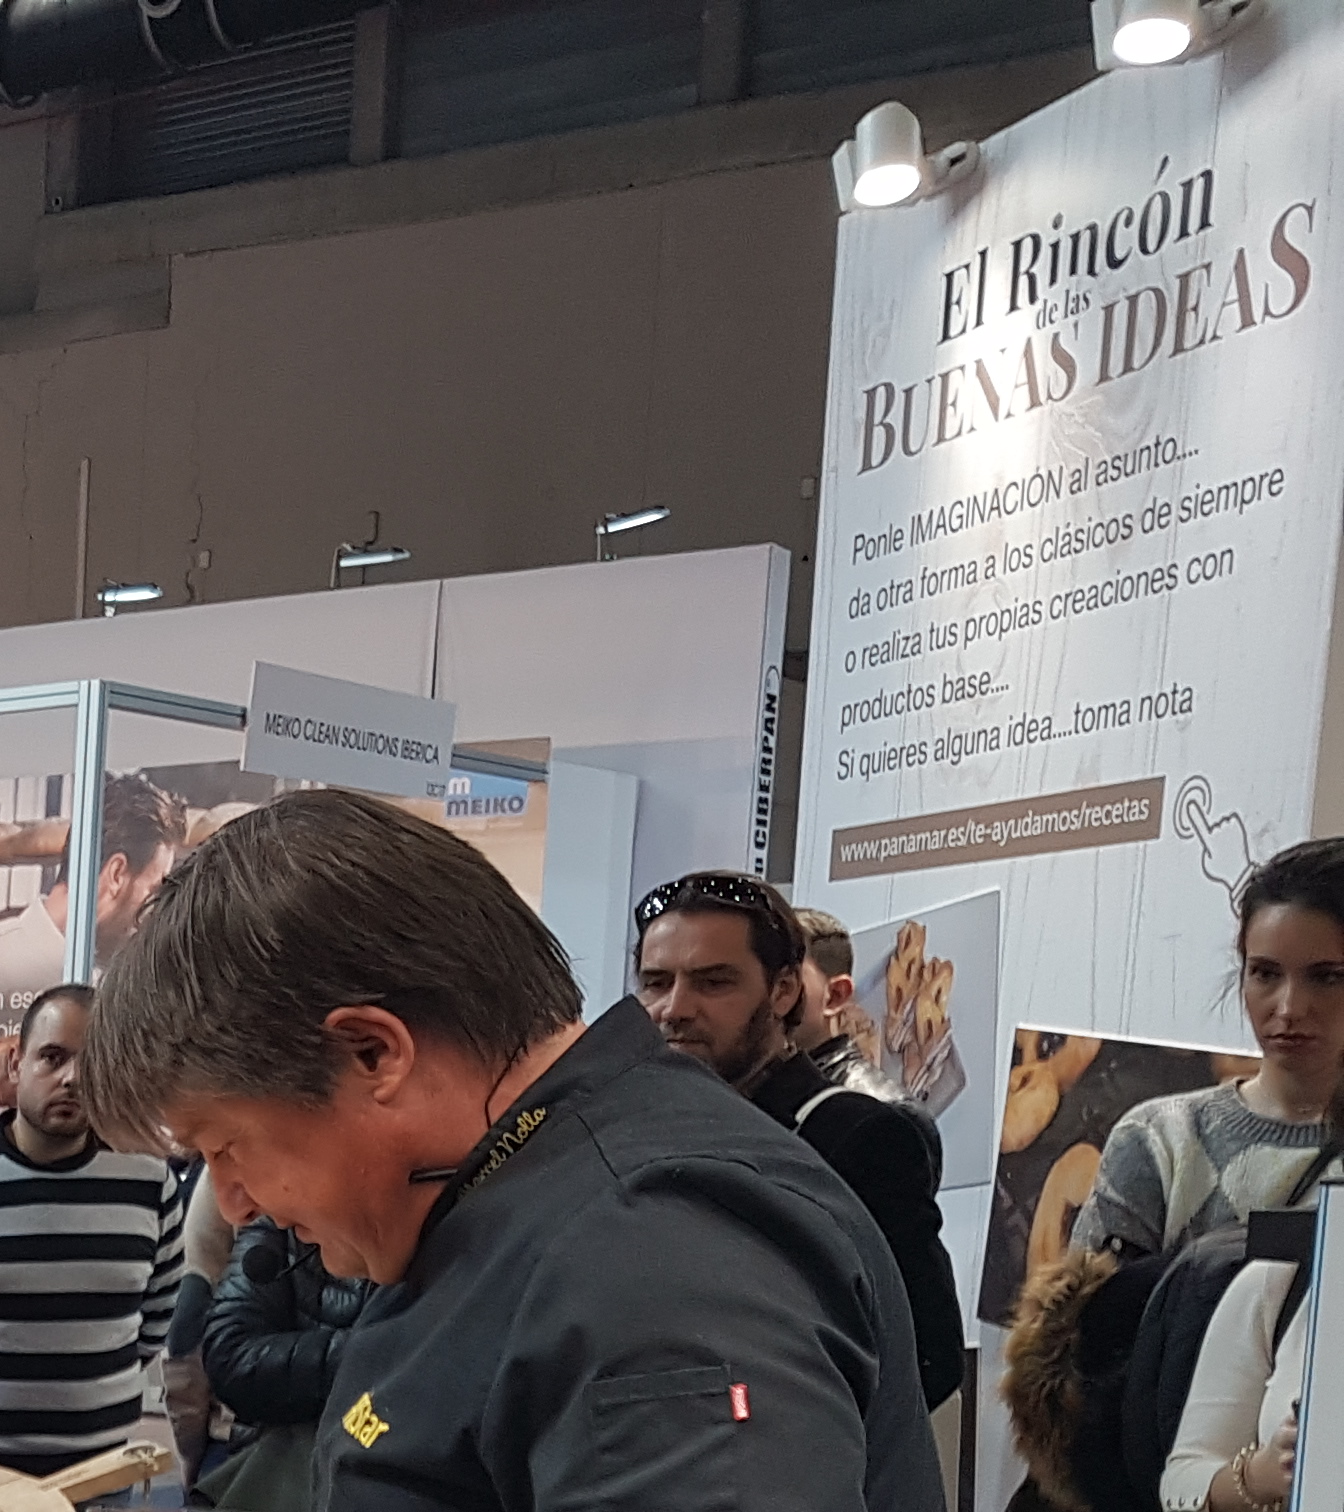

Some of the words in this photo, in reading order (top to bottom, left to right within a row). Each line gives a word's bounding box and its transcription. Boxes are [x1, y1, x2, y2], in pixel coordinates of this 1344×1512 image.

[936, 246, 989, 346] El
[1005, 155, 1215, 316] Rincón
[856, 320, 1079, 476] BUENAS
[1096, 197, 1316, 386] IDEAS
[1036, 299, 1059, 330] de
[1063, 289, 1091, 319] las
[848, 588, 871, 620] da
[876, 578, 914, 612] otra
[920, 560, 979, 599] forma
[984, 554, 996, 580] a
[1003, 542, 1034, 575] los
[1040, 512, 1134, 563] clásicos
[1141, 496, 1172, 534] de
[1178, 467, 1285, 524] siempre
[852, 523, 905, 566] Ponle
[909, 465, 1064, 547] IMAGINACIÓN
[1069, 457, 1090, 495] al
[844, 649, 857, 674] o
[861, 629, 922, 670] realiza
[929, 621, 959, 652] tus
[964, 597, 1044, 650] propias
[1049, 562, 1179, 621] creaciones
[1186, 547, 1234, 585] con
[264, 711, 301, 740] MEIKO
[303, 718, 341, 747] CLEAN
[341, 727, 399, 759] SOLUTIONS
[400, 738, 440, 766] IBERICA
[837, 748, 856, 781] Si
[859, 740, 928, 783] quieres
[934, 726, 1001, 766] alguna
[1137, 682, 1195, 723] nota
[840, 683, 936, 736] productos
[754, 692, 777, 851] CIBERPAN
[840, 797, 1151, 863] www.panamar.es/te-ayudamos/recetas
[496, 1106, 547, 1154] Nolla
